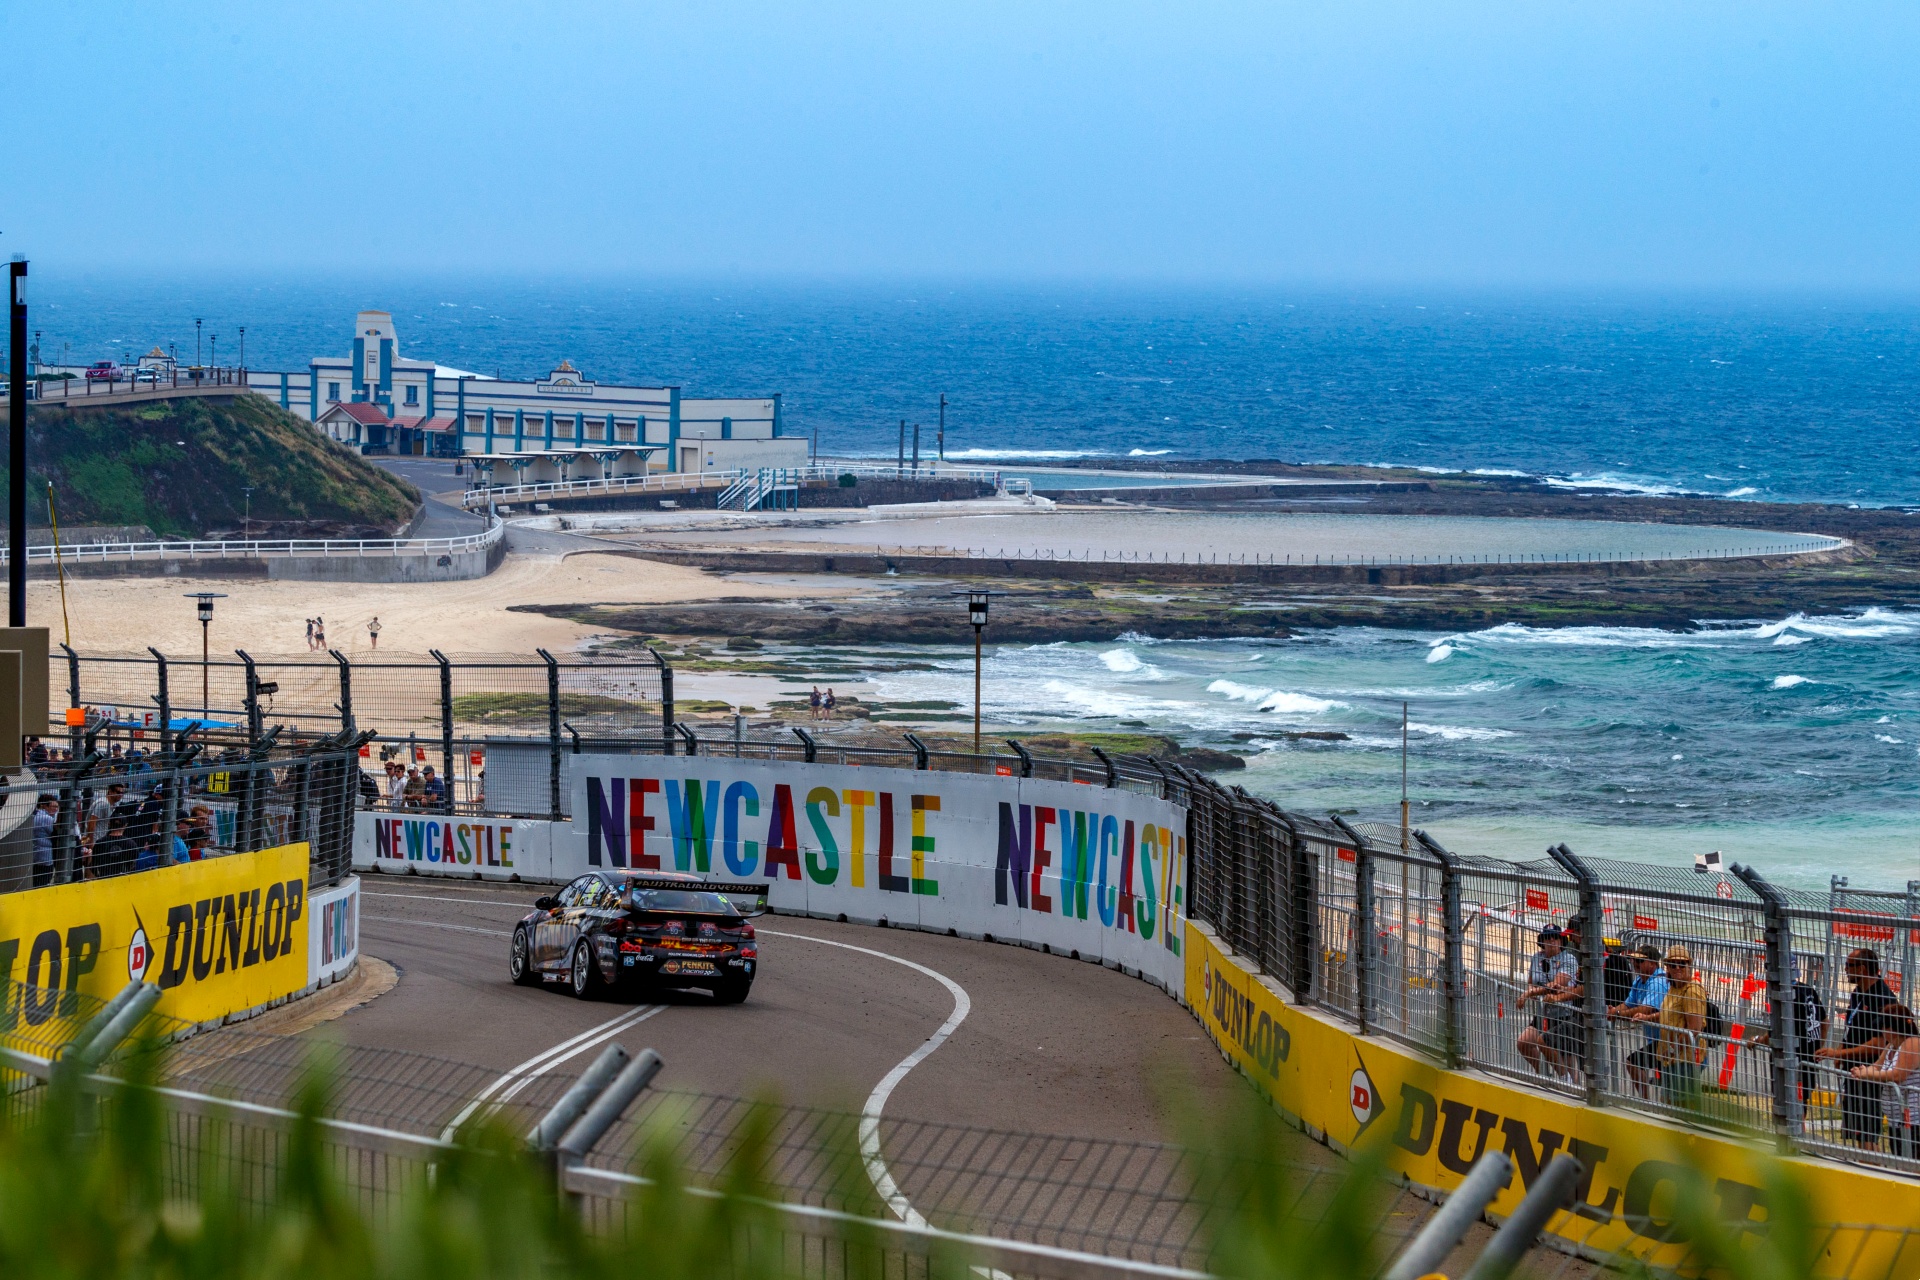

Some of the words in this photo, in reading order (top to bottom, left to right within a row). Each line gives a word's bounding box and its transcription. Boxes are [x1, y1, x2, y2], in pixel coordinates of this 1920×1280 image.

[101, 710, 112, 718] 5.1
[145, 713, 153, 727] F
[375, 818, 513, 868] NEWCASTLE
[586, 777, 941, 897] NEWCASTLE
[995, 801, 1185, 958] NEWCASTLE
[158, 878, 303, 990] DUNLOP
[682, 961, 715, 970] PENRITE
[1213, 968, 1290, 1081] DUNLOP
[1352, 1085, 1370, 1111] D
[1393, 1083, 1777, 1262] DUNLOP
